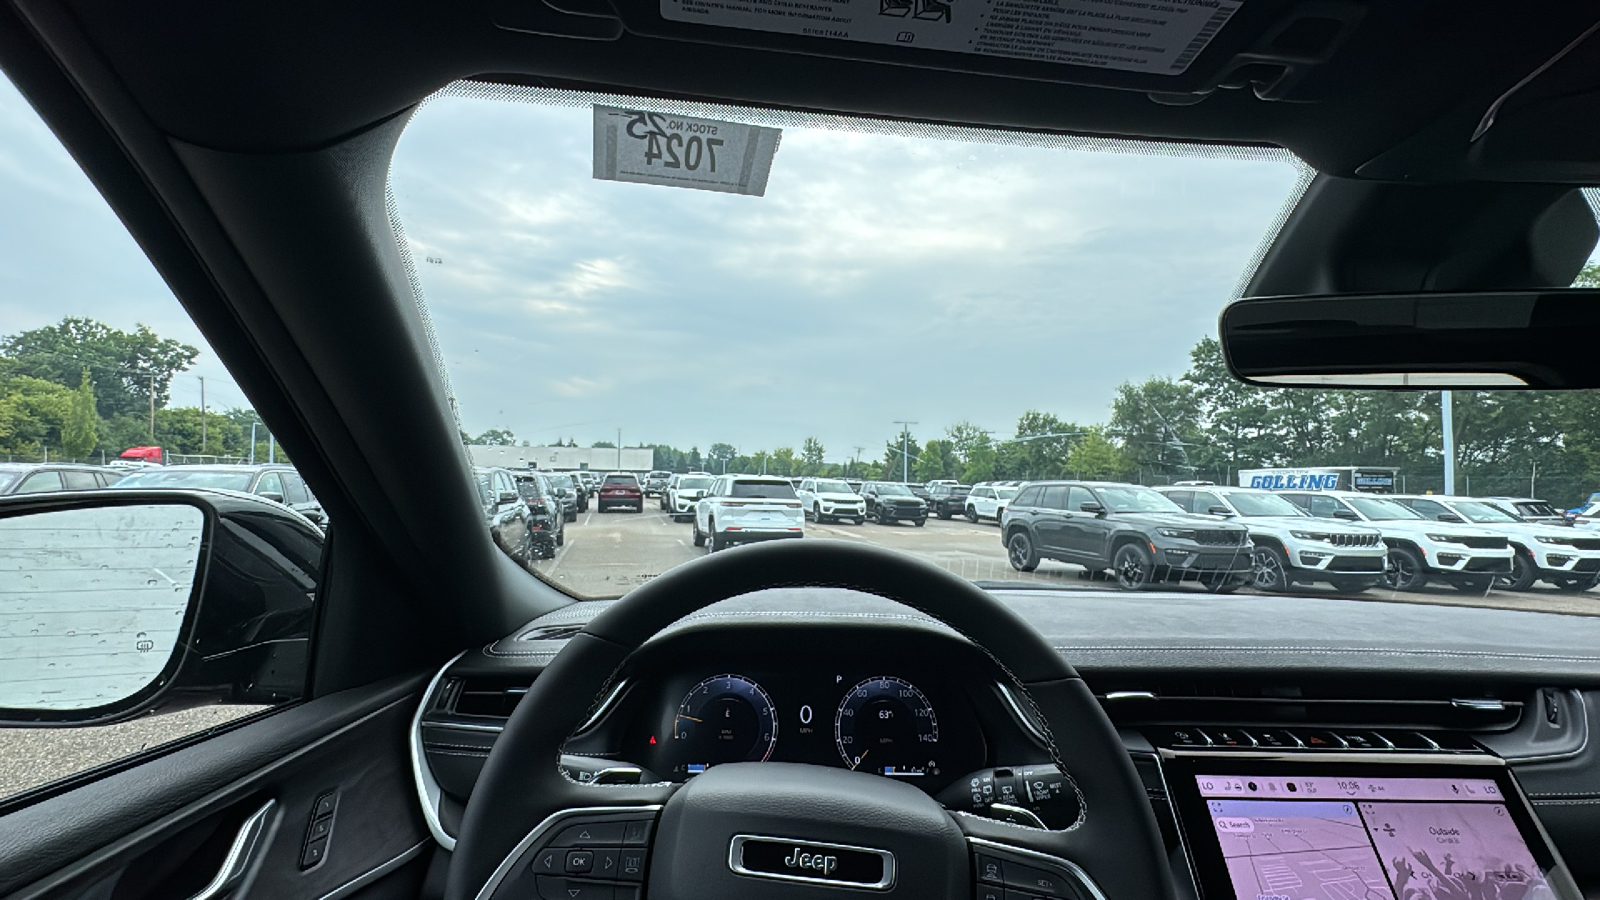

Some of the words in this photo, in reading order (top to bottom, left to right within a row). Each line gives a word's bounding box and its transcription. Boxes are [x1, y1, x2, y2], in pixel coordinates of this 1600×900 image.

[1250, 474, 1338, 489] GOLLING
[836, 675, 842, 683] P
[799, 705, 813, 724] 0
[843, 709, 854, 717] 40
[914, 709, 929, 717] 120
[764, 733, 770, 741] 6
[842, 736, 853, 744] 20
[918, 734, 933, 742] 140
[854, 756, 861, 764] 0
[1338, 781, 1360, 790] 10:06
[1229, 821, 1250, 829] Search
[1429, 827, 1460, 836] Outside
[572, 857, 586, 866] OK
[785, 848, 838, 875] Jeep
